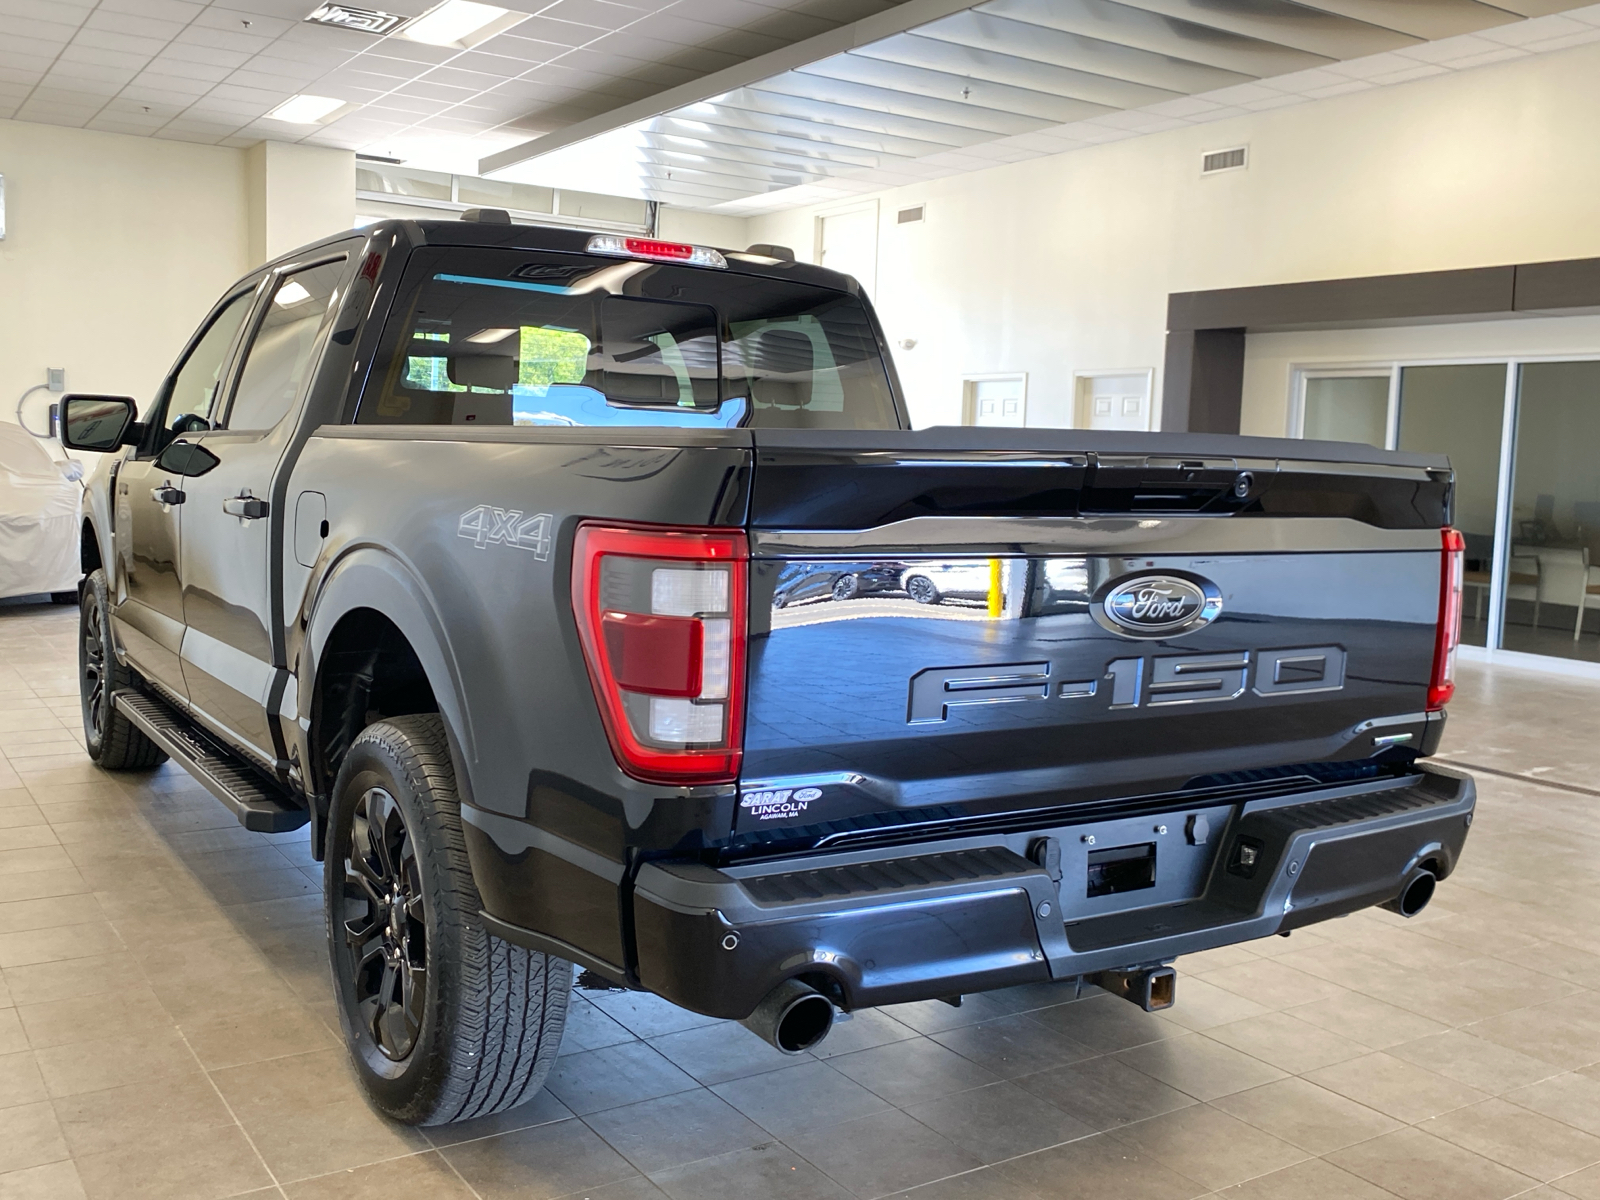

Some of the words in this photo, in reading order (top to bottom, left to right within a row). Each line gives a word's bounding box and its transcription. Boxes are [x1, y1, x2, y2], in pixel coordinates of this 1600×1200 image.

[1132, 588, 1186, 619] Ford
[907, 644, 1347, 726] F-150
[741, 790, 793, 807] SARAT
[751, 801, 808, 815] LINCOLN
[760, 812, 788, 820] AGAWAM,
